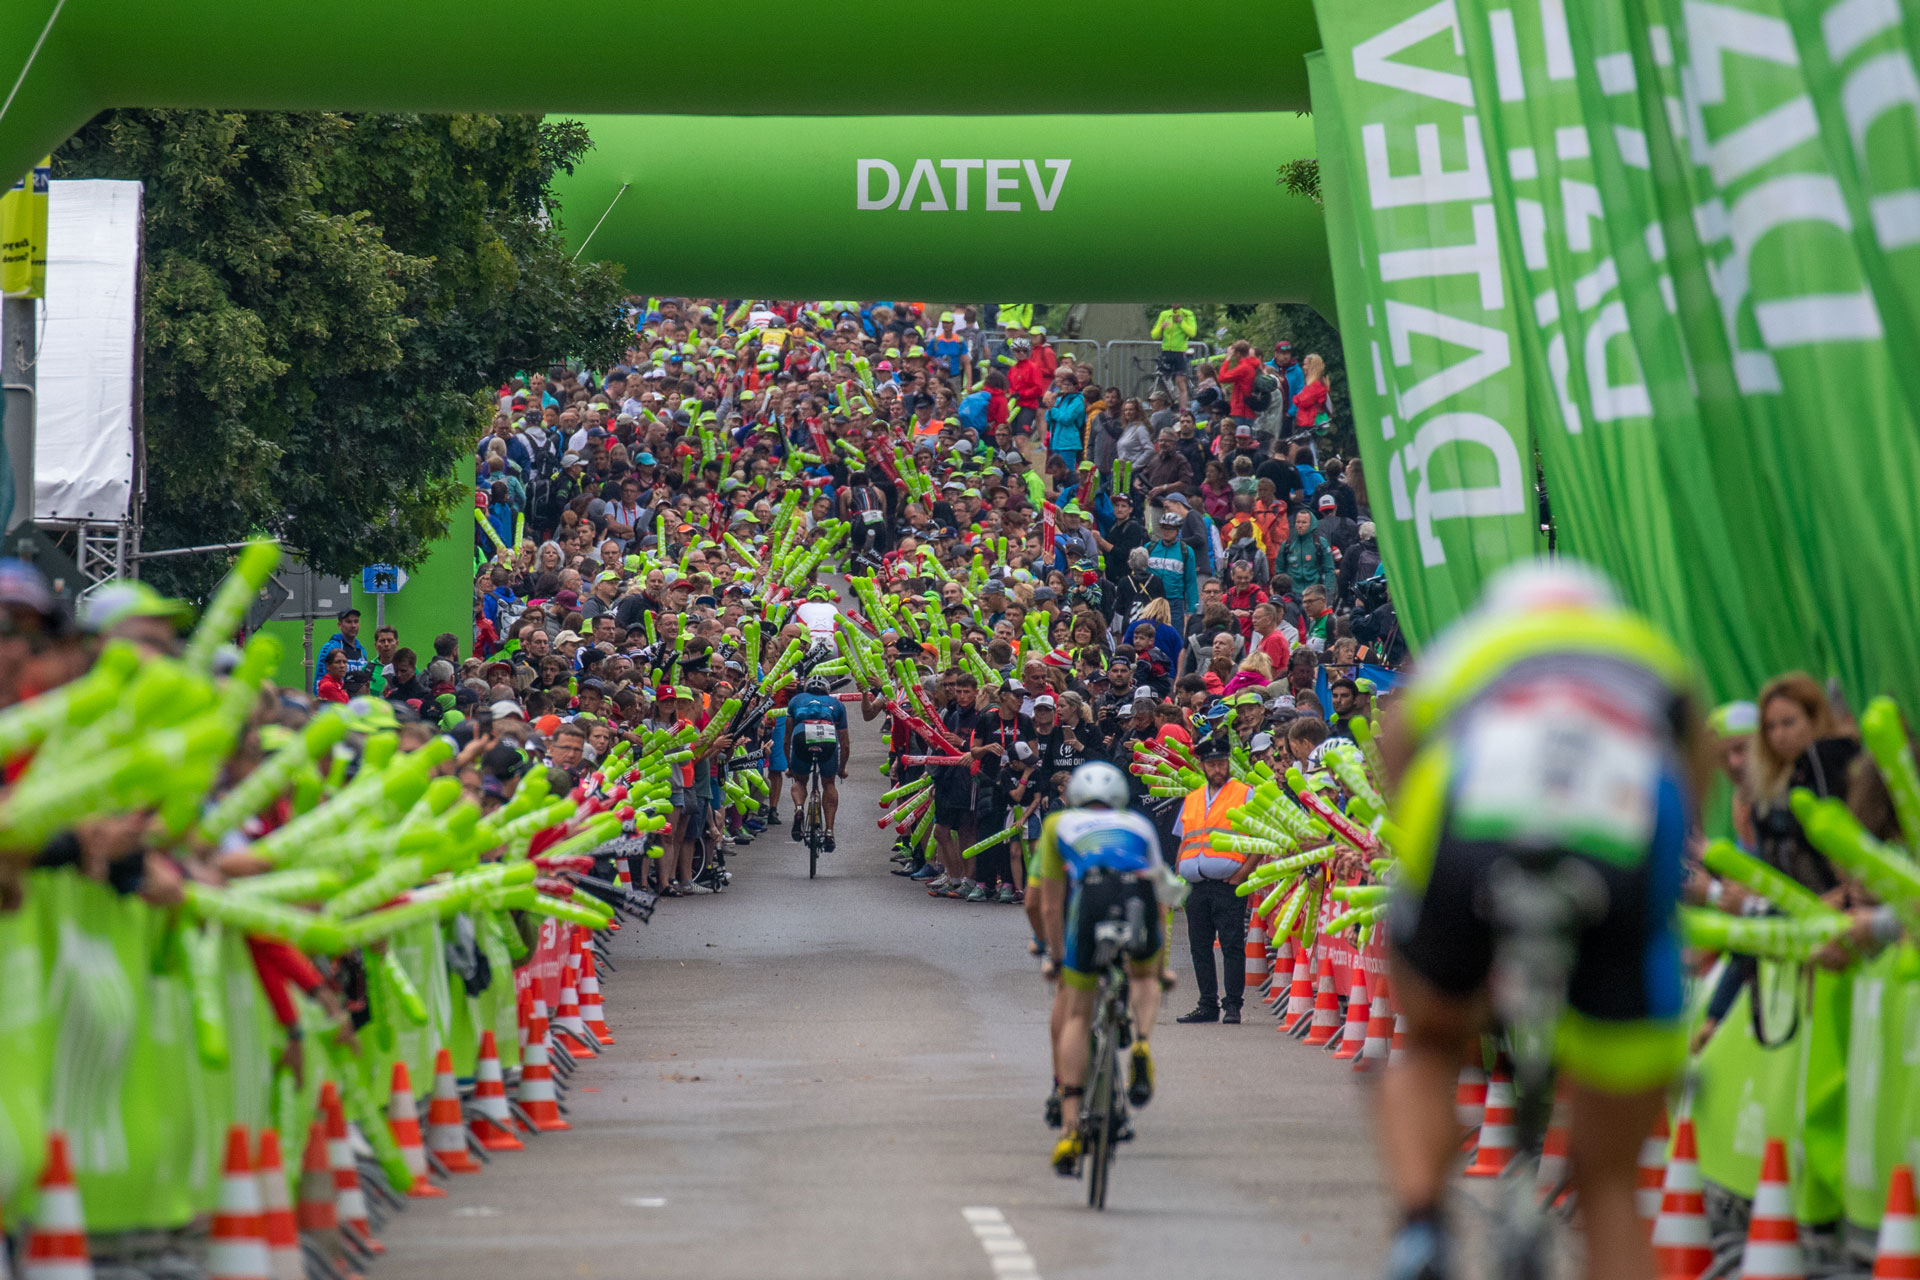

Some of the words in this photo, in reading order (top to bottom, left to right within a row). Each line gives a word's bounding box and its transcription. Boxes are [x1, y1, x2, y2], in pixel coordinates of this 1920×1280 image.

[857, 158, 1072, 212] DATEV
[766, 648, 789, 680] DATEV
[812, 647, 826, 662] JOKA
[741, 683, 756, 700] JOKA
[757, 697, 774, 713] JOKA
[702, 711, 725, 736] ATEV
[905, 790, 928, 809] ATEV
[1276, 795, 1309, 824] ATEV
[1244, 816, 1290, 844] DATEV
[1274, 847, 1326, 868] DATEV
